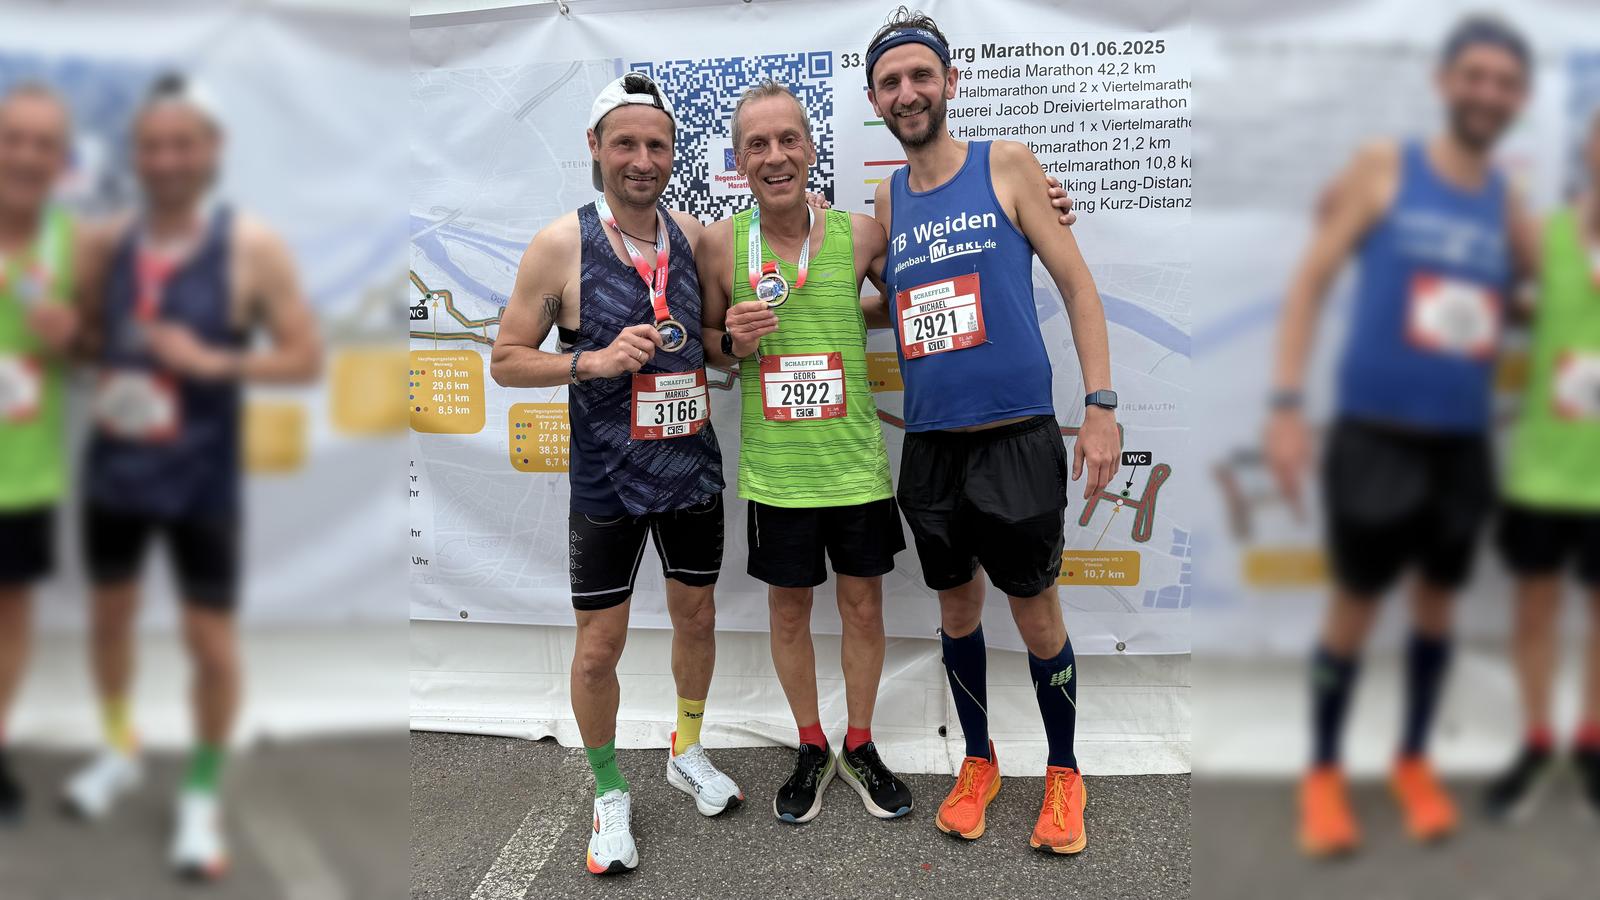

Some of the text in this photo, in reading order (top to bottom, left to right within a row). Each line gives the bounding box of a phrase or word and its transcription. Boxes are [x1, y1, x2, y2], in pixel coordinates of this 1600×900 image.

[981, 42, 1065, 59] Marathon
[1070, 40, 1165, 56] 01.06.2025
[841, 53, 865, 68] 33.
[977, 65, 1021, 79] media
[1025, 63, 1093, 77] Marathon
[1097, 62, 1129, 77] 42,2
[1134, 62, 1156, 74] km
[959, 84, 1048, 98] Halbmarathon
[1052, 82, 1075, 93] und
[1079, 82, 1087, 92] 2
[1091, 84, 1098, 92] x
[947, 96, 1187, 118] auerei Jacob Dreiviertelmarathon
[959, 124, 1047, 137] Halbmarathon
[1050, 121, 1074, 133] und
[1080, 121, 1085, 132] 1
[1090, 123, 1097, 131] x
[1028, 137, 1170, 154] lbmarathon 21,2 km
[1042, 158, 1140, 173] ertelmarathon
[1146, 156, 1176, 171] 10,8
[1100, 196, 1191, 211] Kurz-Distanz
[892, 212, 997, 256] TB Weiden
[919, 300, 947, 313] MICHAEL
[913, 310, 958, 340] 2921
[432, 369, 469, 378] 19,0 km
[793, 372, 816, 380] GEORG
[454, 381, 469, 390] km
[455, 393, 470, 402] km
[665, 390, 689, 399] MARKUS
[781, 382, 830, 405] 2922
[438, 405, 470, 415] 8,5 km
[654, 399, 697, 425] 3166
[539, 421, 558, 431] 17,2
[538, 433, 558, 443] 27,8
[538, 445, 559, 456] 38,3
[545, 457, 559, 467] 6,7
[1126, 454, 1147, 463] WC
[412, 556, 429, 566] Uhr
[1084, 569, 1125, 579] 10,7 km
